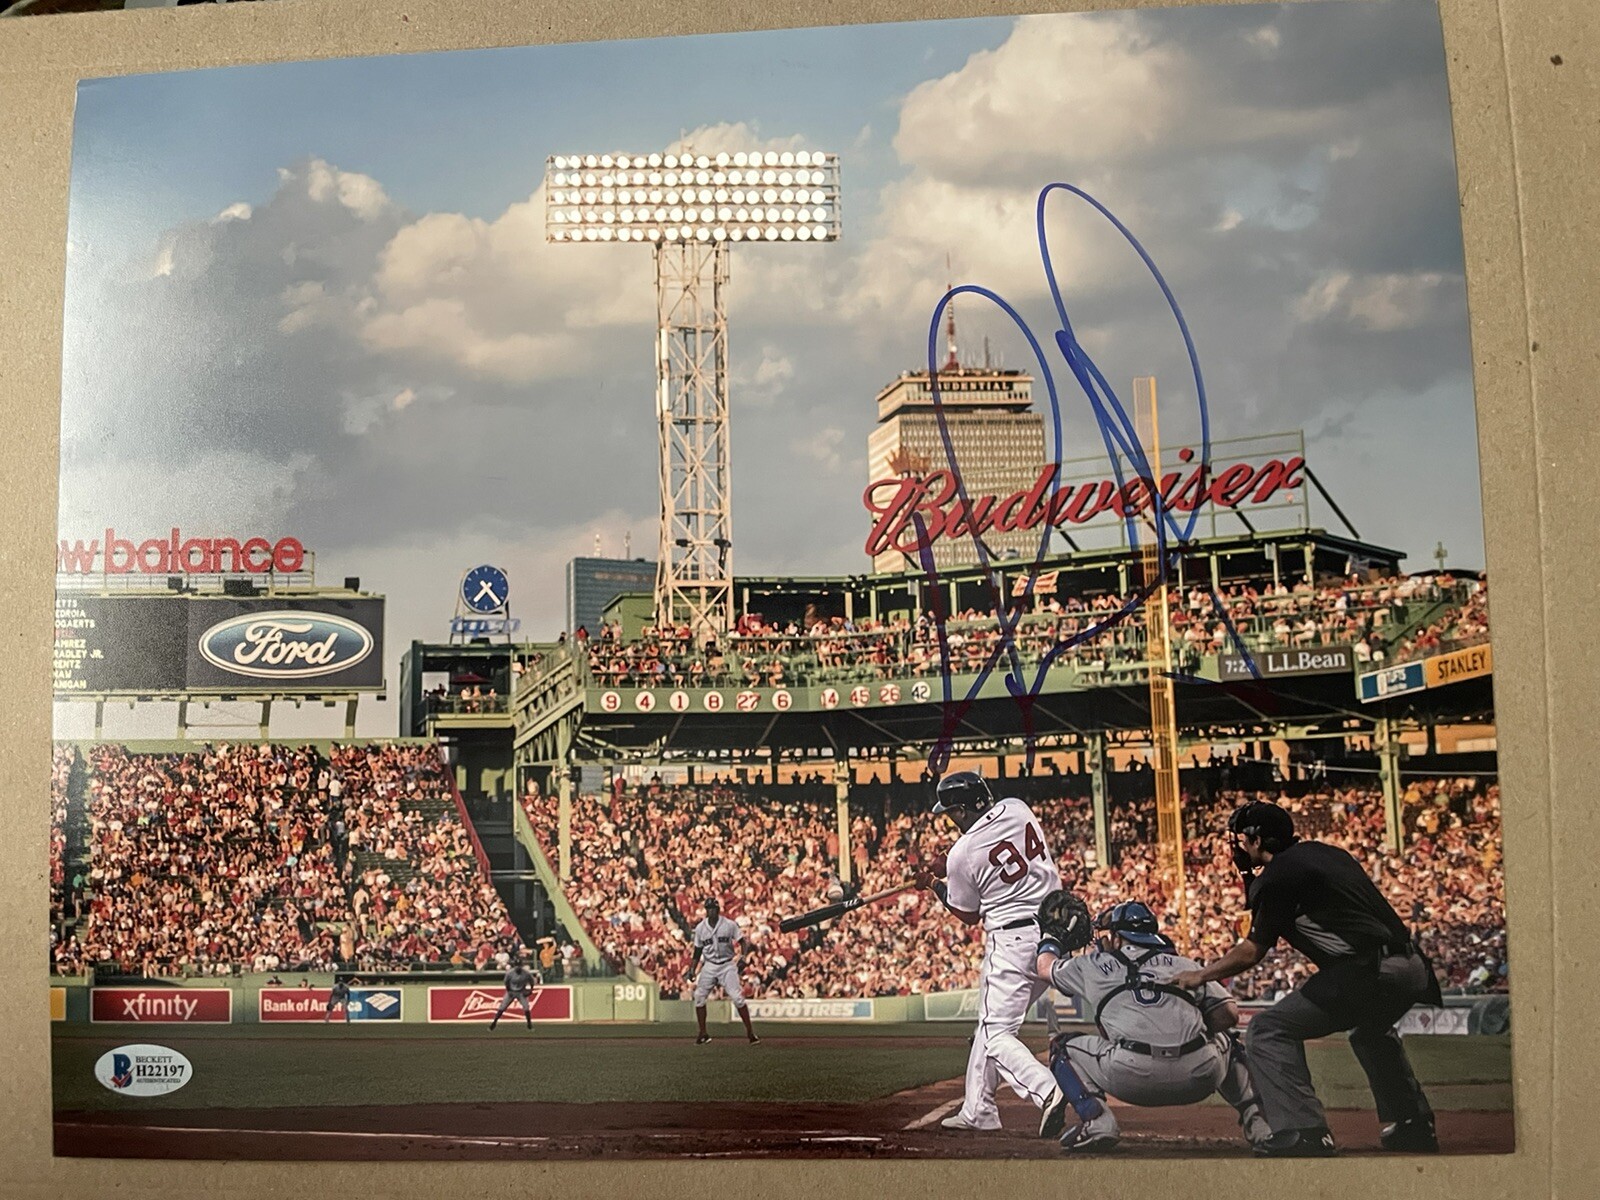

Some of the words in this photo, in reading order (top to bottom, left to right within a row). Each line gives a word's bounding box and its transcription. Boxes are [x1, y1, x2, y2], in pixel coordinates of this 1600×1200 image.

[926, 381, 1010, 391] PUDENTIAL
[863, 447, 1306, 556] Budweiser
[104, 527, 304, 575] balance
[233, 619, 338, 665] Ford
[1437, 651, 1486, 679] STANLEY
[606, 694, 617, 709] 9
[640, 694, 650, 709] 4
[708, 694, 720, 709] 8
[736, 693, 761, 710] 27
[777, 693, 789, 708] 6
[820, 691, 837, 707] 14
[849, 688, 870, 704] 45
[880, 686, 901, 703] 26
[911, 685, 928, 701] 42
[987, 821, 1047, 885] 34
[614, 984, 646, 1000] 380
[122, 992, 199, 1020] xfinity
[263, 999, 295, 1012] Bank
[296, 999, 309, 1012] of
[750, 1002, 801, 1017] TOYO
[801, 1002, 855, 1017] TIRES
[136, 1064, 185, 1077] H22197
